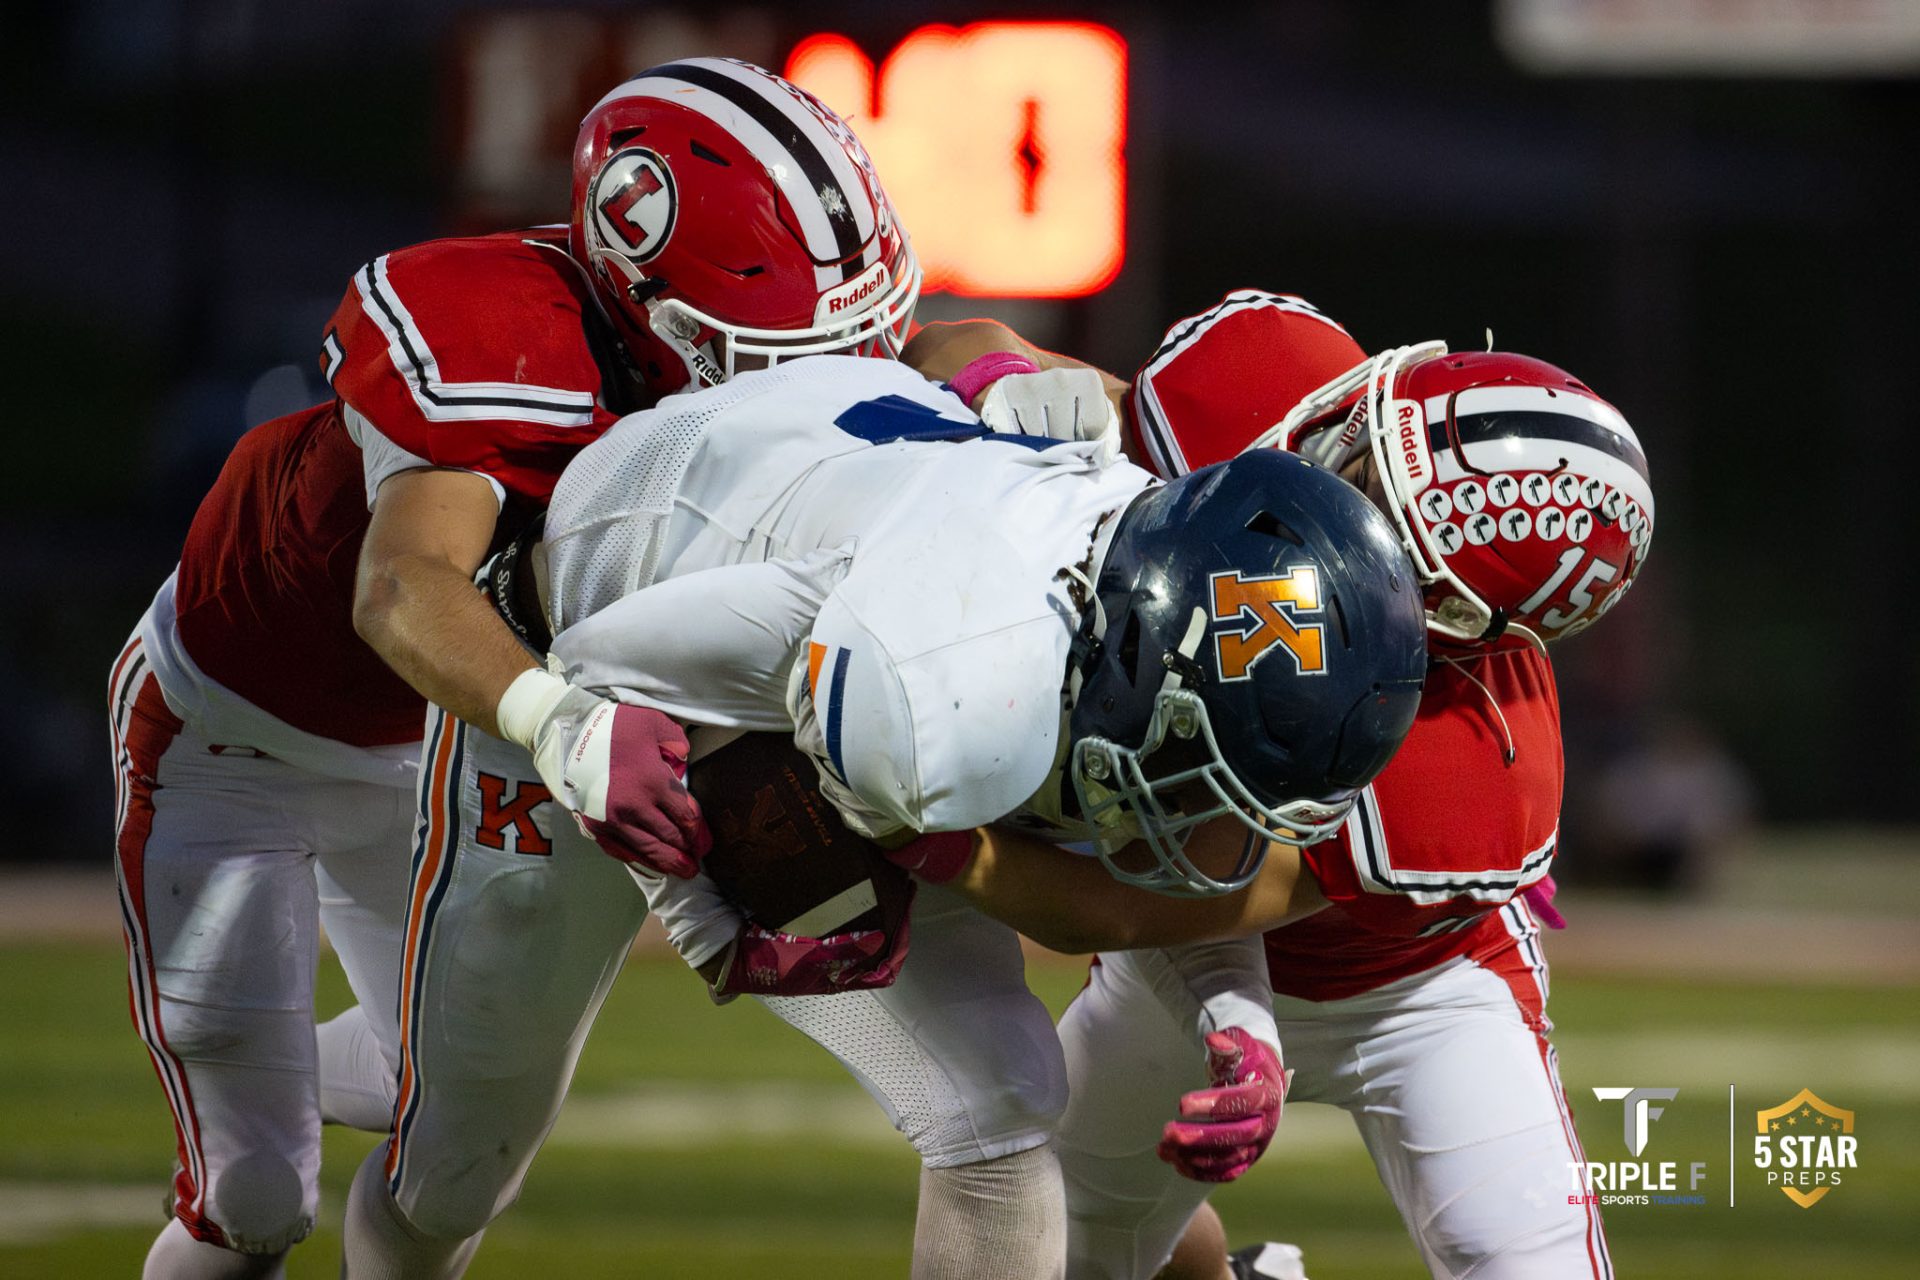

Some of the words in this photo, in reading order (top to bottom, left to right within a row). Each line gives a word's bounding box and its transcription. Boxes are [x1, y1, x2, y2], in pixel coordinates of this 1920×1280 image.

[829, 268, 885, 314] Riddell
[1398, 405, 1423, 479] Riddell
[1209, 565, 1329, 683] K
[1517, 546, 1619, 630] 15
[475, 770, 553, 856] K
